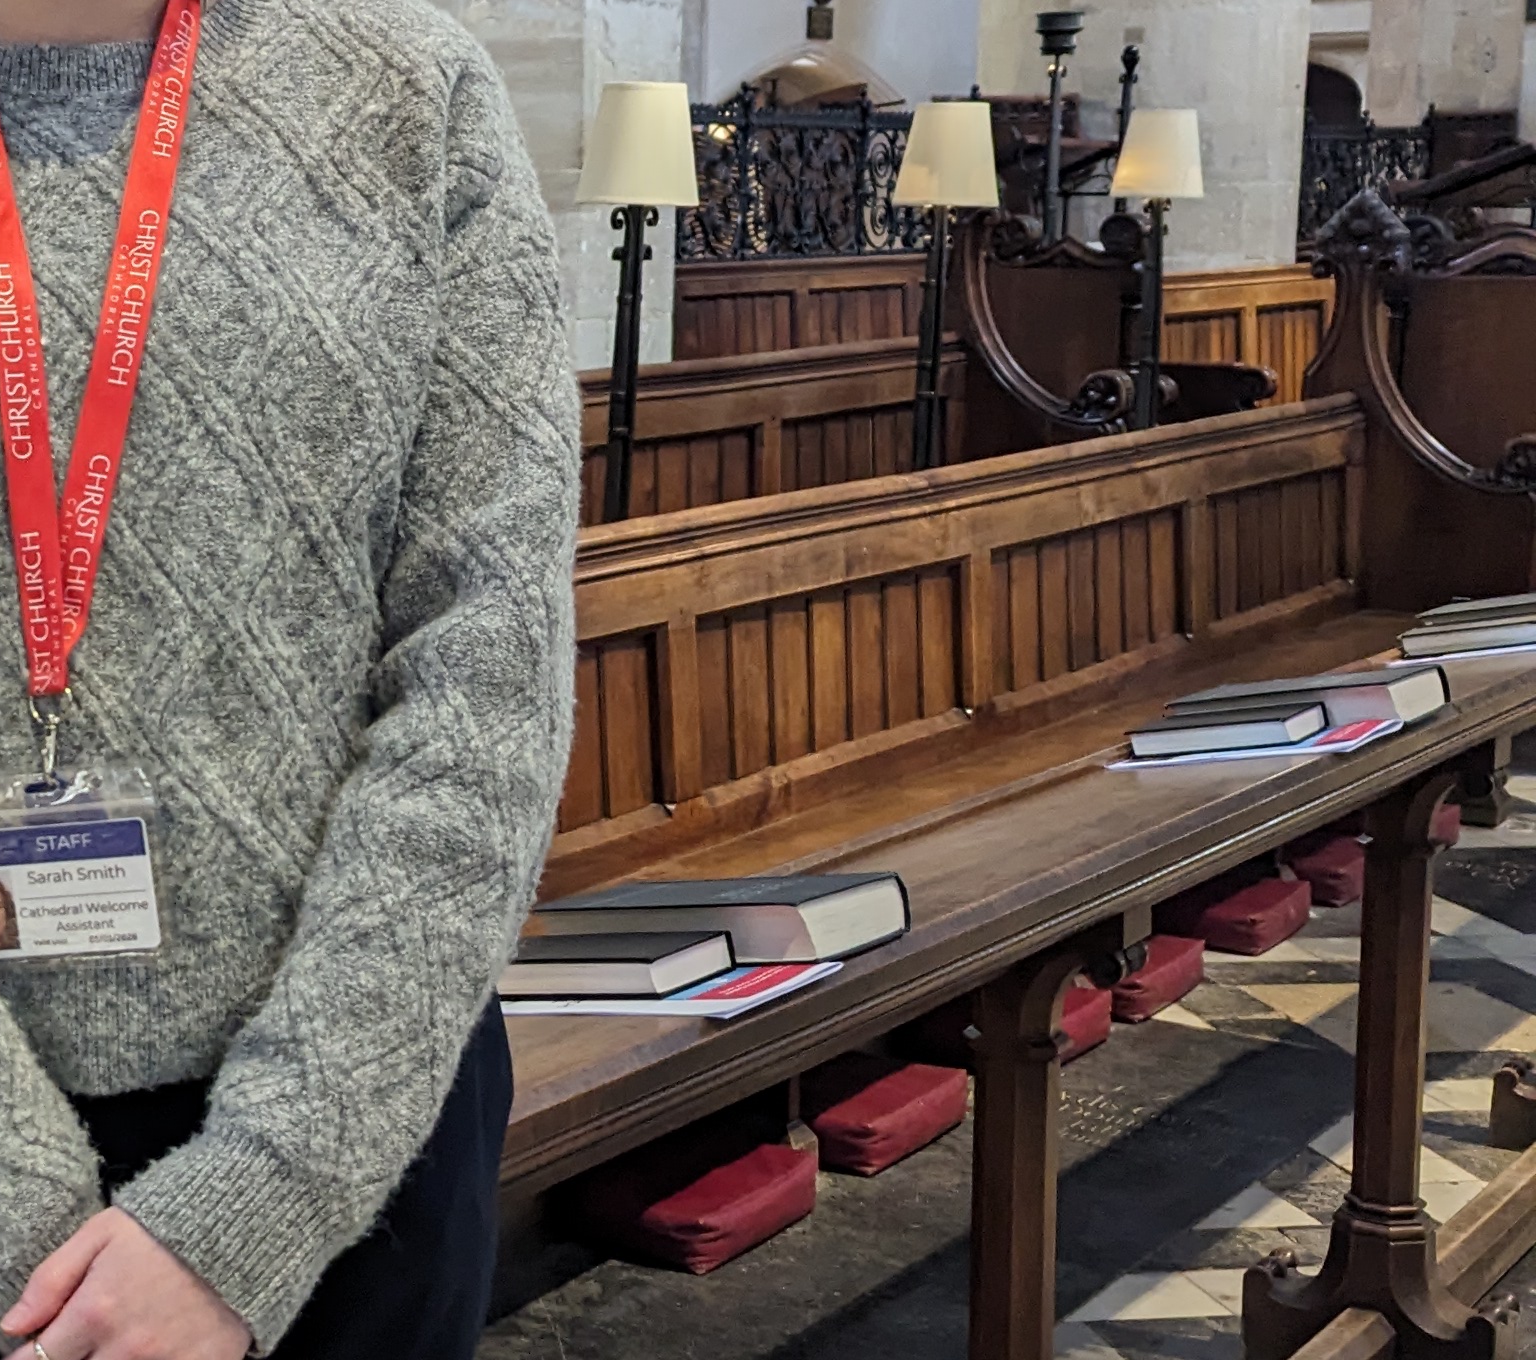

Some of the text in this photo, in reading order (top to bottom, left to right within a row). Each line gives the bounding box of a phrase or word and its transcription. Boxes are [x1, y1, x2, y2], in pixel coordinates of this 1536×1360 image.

[152, 10, 196, 158] CHRIST CHURCH
[103, 244, 129, 335] CATHEDRAL
[107, 209, 160, 386] CHRIST CHURCH
[23, 304, 42, 410] CATHEDRAL
[5, 368, 33, 460] CHRIST
[75, 454, 111, 544] CHRIST
[20, 531, 55, 695] RIST CHURCH
[27, 865, 126, 885] Sarah Smith
[35, 833, 92, 852] STAFF
[19, 900, 149, 918] Cathedral Welcome
[56, 919, 115, 932] Assistant
